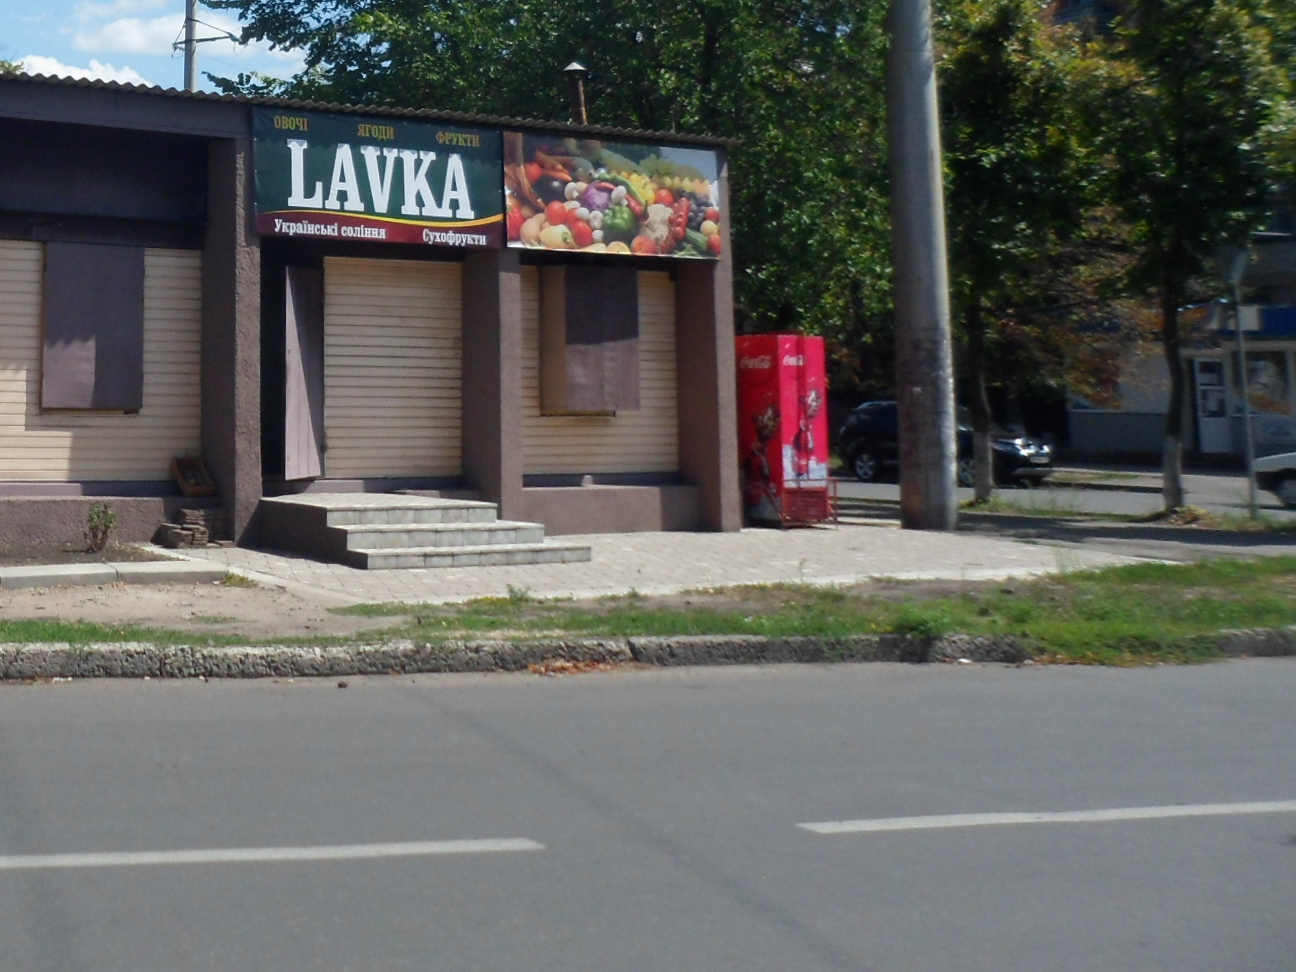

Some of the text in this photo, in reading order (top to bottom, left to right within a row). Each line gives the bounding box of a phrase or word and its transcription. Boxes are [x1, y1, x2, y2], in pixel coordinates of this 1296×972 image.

[274, 115, 480, 148] ОВОЧІ ЯГОДИ ФРУКТИ
[287, 138, 475, 220] LAVKA
[274, 218, 386, 240] Українські соління
[422, 228, 487, 247] Сухофрукти
